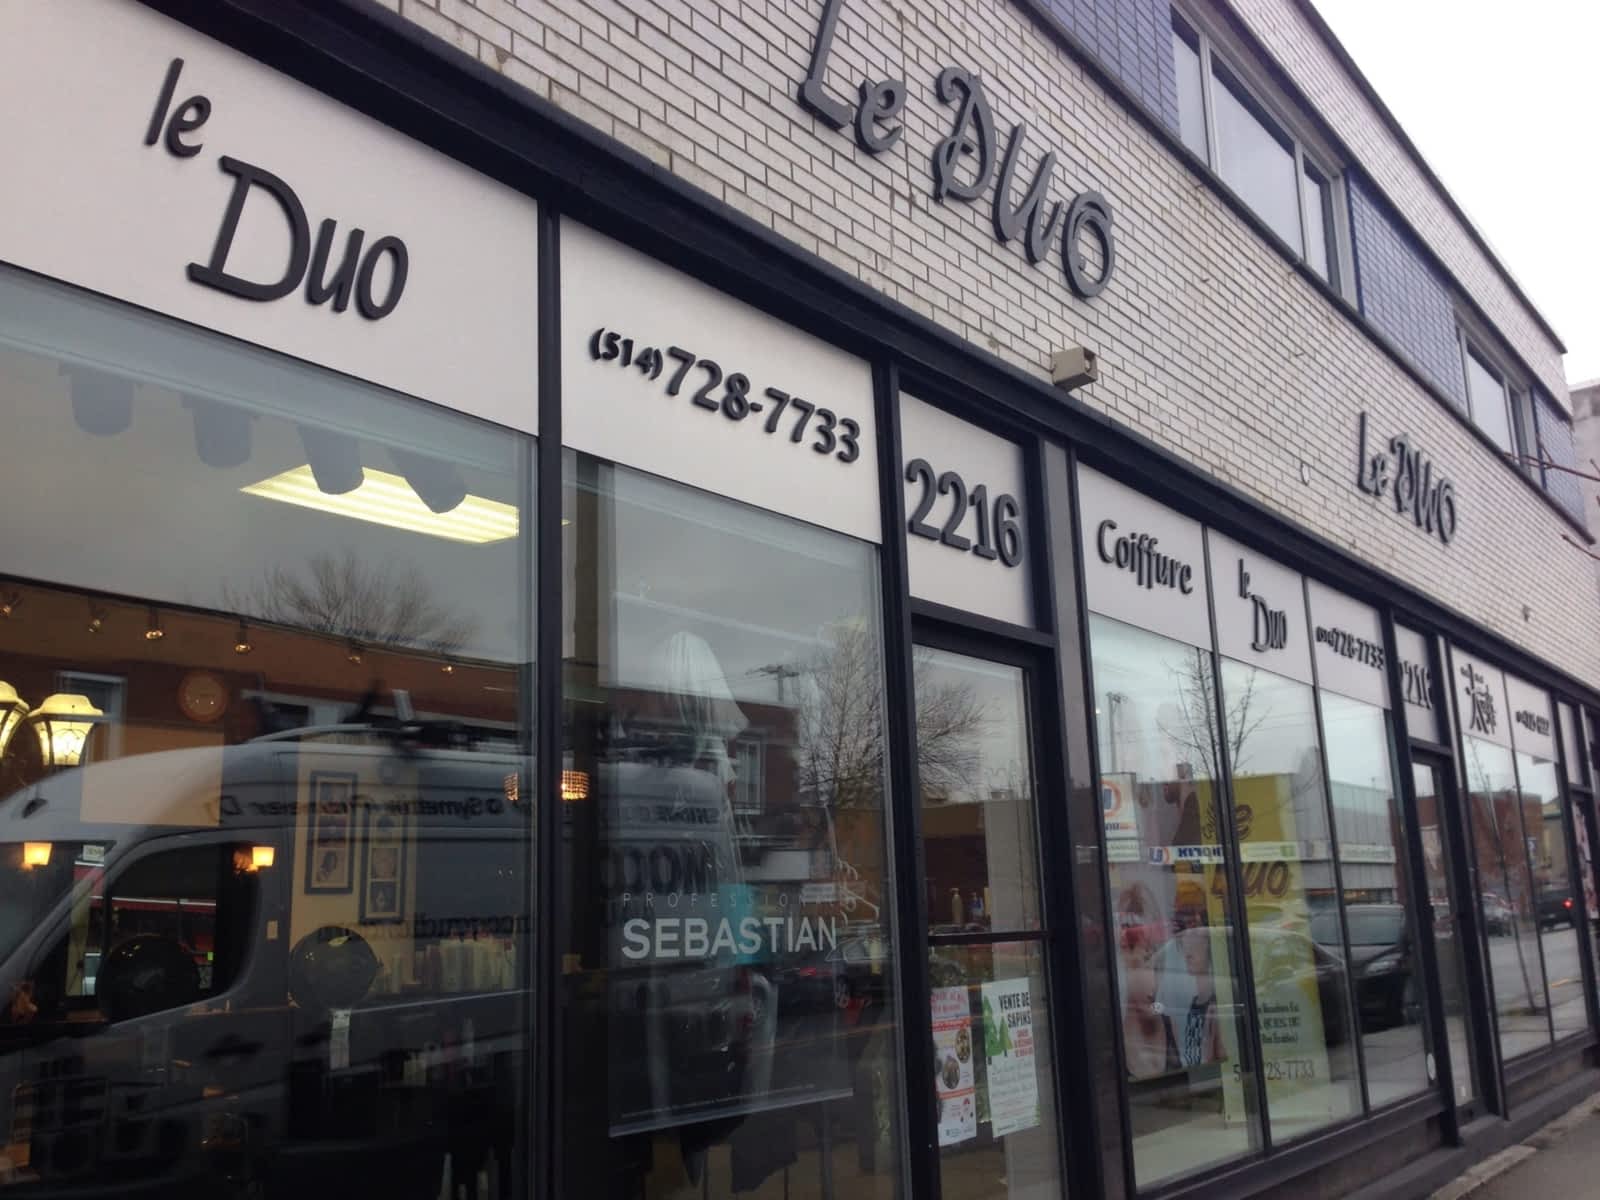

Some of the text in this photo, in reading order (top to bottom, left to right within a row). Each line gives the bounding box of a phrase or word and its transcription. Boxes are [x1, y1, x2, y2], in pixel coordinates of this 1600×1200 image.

[144, 57, 212, 158] le
[797, 0, 906, 155] Le
[185, 155, 409, 321] Duo
[589, 327, 861, 464] (514)728-7733
[1357, 411, 1388, 496] Le
[906, 458, 1024, 568] 2216
[1097, 519, 1193, 595] Coiffure
[1250, 594, 1287, 652] Duo
[621, 914, 837, 960] SEBASTIAN
